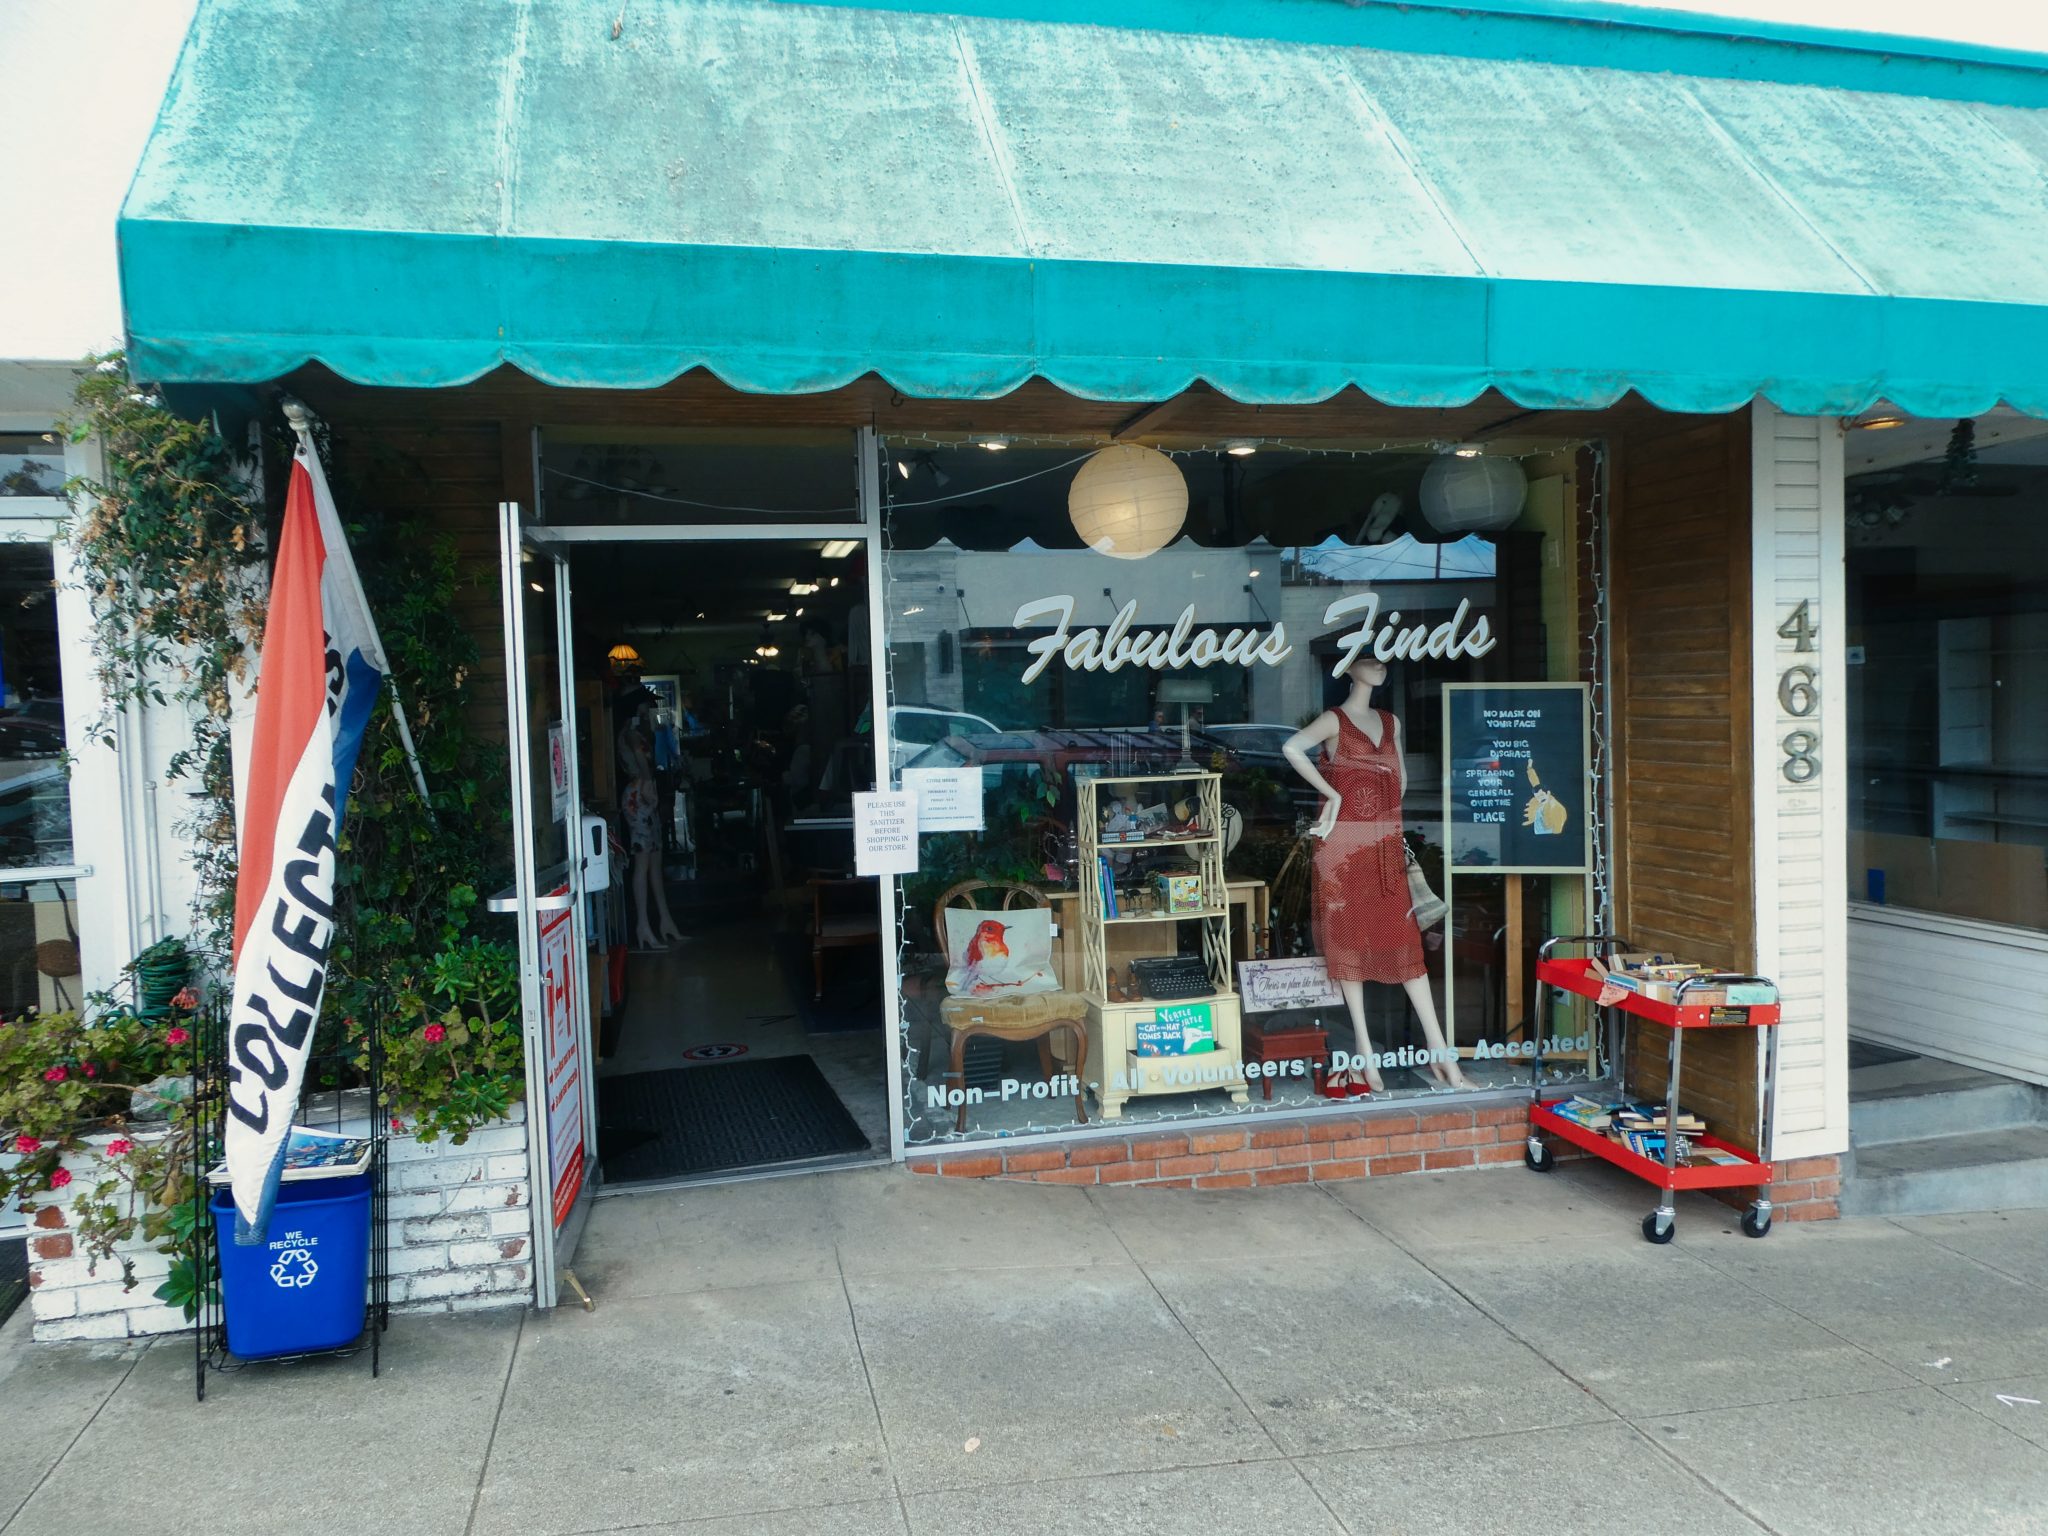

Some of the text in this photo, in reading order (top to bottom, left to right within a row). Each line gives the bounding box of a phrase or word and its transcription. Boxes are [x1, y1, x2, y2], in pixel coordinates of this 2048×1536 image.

[1013, 592, 1496, 685] Fabulous Finds
[1483, 709, 1540, 718] NO MASK ON
[1486, 719, 1536, 728] YOUR FACE
[1492, 740, 1529, 748] YOU BIG
[1490, 749, 1531, 758] DISGRACE
[1465, 769, 1515, 778] SPREADING
[1478, 778, 1502, 787] YOUR
[1468, 788, 1514, 797] GERMS ALL
[867, 800, 906, 809] PLEASE USE
[1470, 798, 1511, 807] OVER THE
[870, 818, 905, 826] SANITIZER
[1473, 812, 1506, 823] PLACE
[874, 827, 900, 835] BEFORE
[867, 836, 900, 844] SHOPPING
[1144, 1024, 1157, 1032] CAT
[1167, 1023, 1180, 1031] HAT
[1138, 1031, 1181, 1040] COMES BACK
[927, 1074, 1080, 1108] Non-Profit
[1111, 1068, 1145, 1090] All
[1163, 1059, 1305, 1086] Volunteers
[1332, 1045, 1460, 1072] Donations
[285, 1231, 303, 1239] WE
[269, 1237, 319, 1250] RECYCLE
